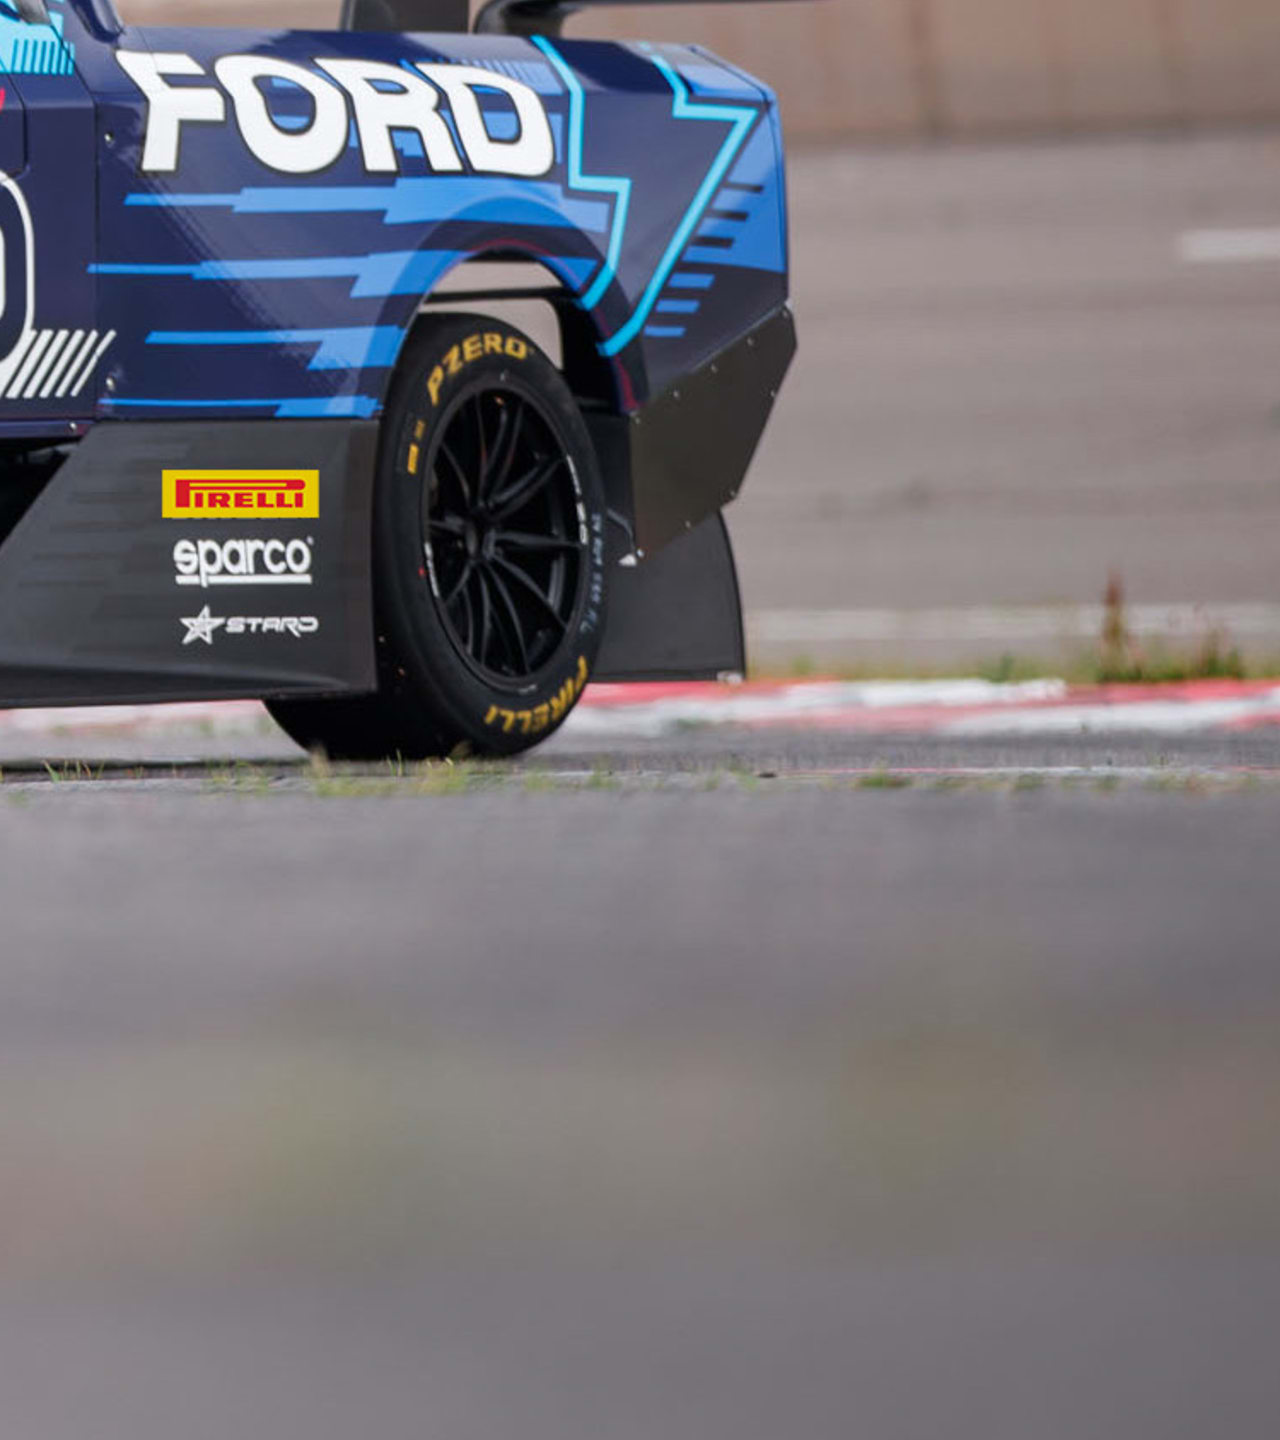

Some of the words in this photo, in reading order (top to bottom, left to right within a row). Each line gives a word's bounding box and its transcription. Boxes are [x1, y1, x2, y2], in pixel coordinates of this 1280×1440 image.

[114, 50, 556, 176] FORD
[175, 479, 306, 508] PIRELLI
[173, 537, 313, 588] sparco
[224, 615, 320, 638] STARD
